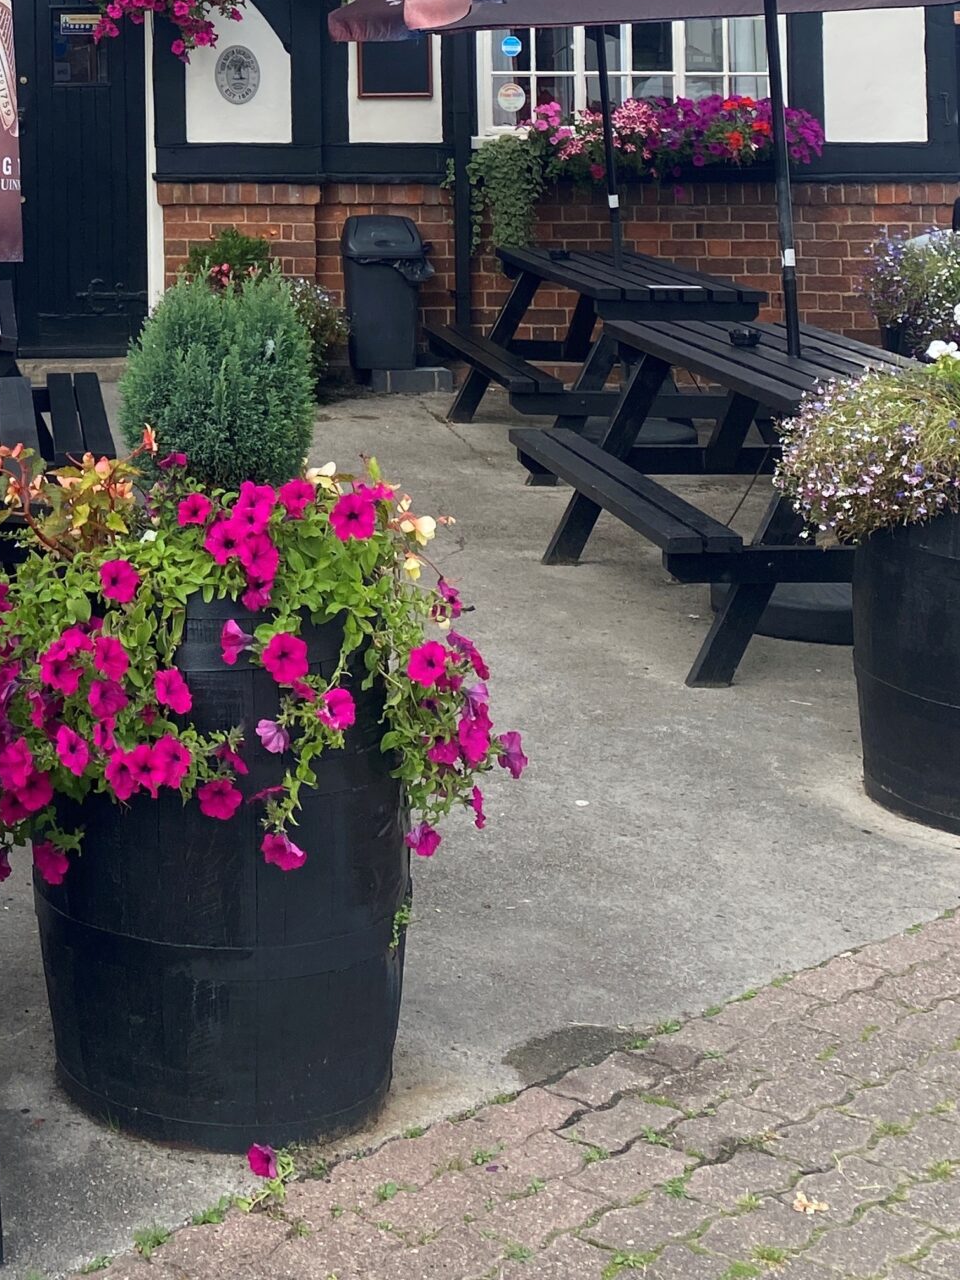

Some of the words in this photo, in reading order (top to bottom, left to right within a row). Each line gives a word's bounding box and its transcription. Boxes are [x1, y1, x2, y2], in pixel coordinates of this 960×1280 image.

[0, 87, 12, 116] 1759
[225, 88, 236, 99] EST
[238, 87, 252, 100] 1849
